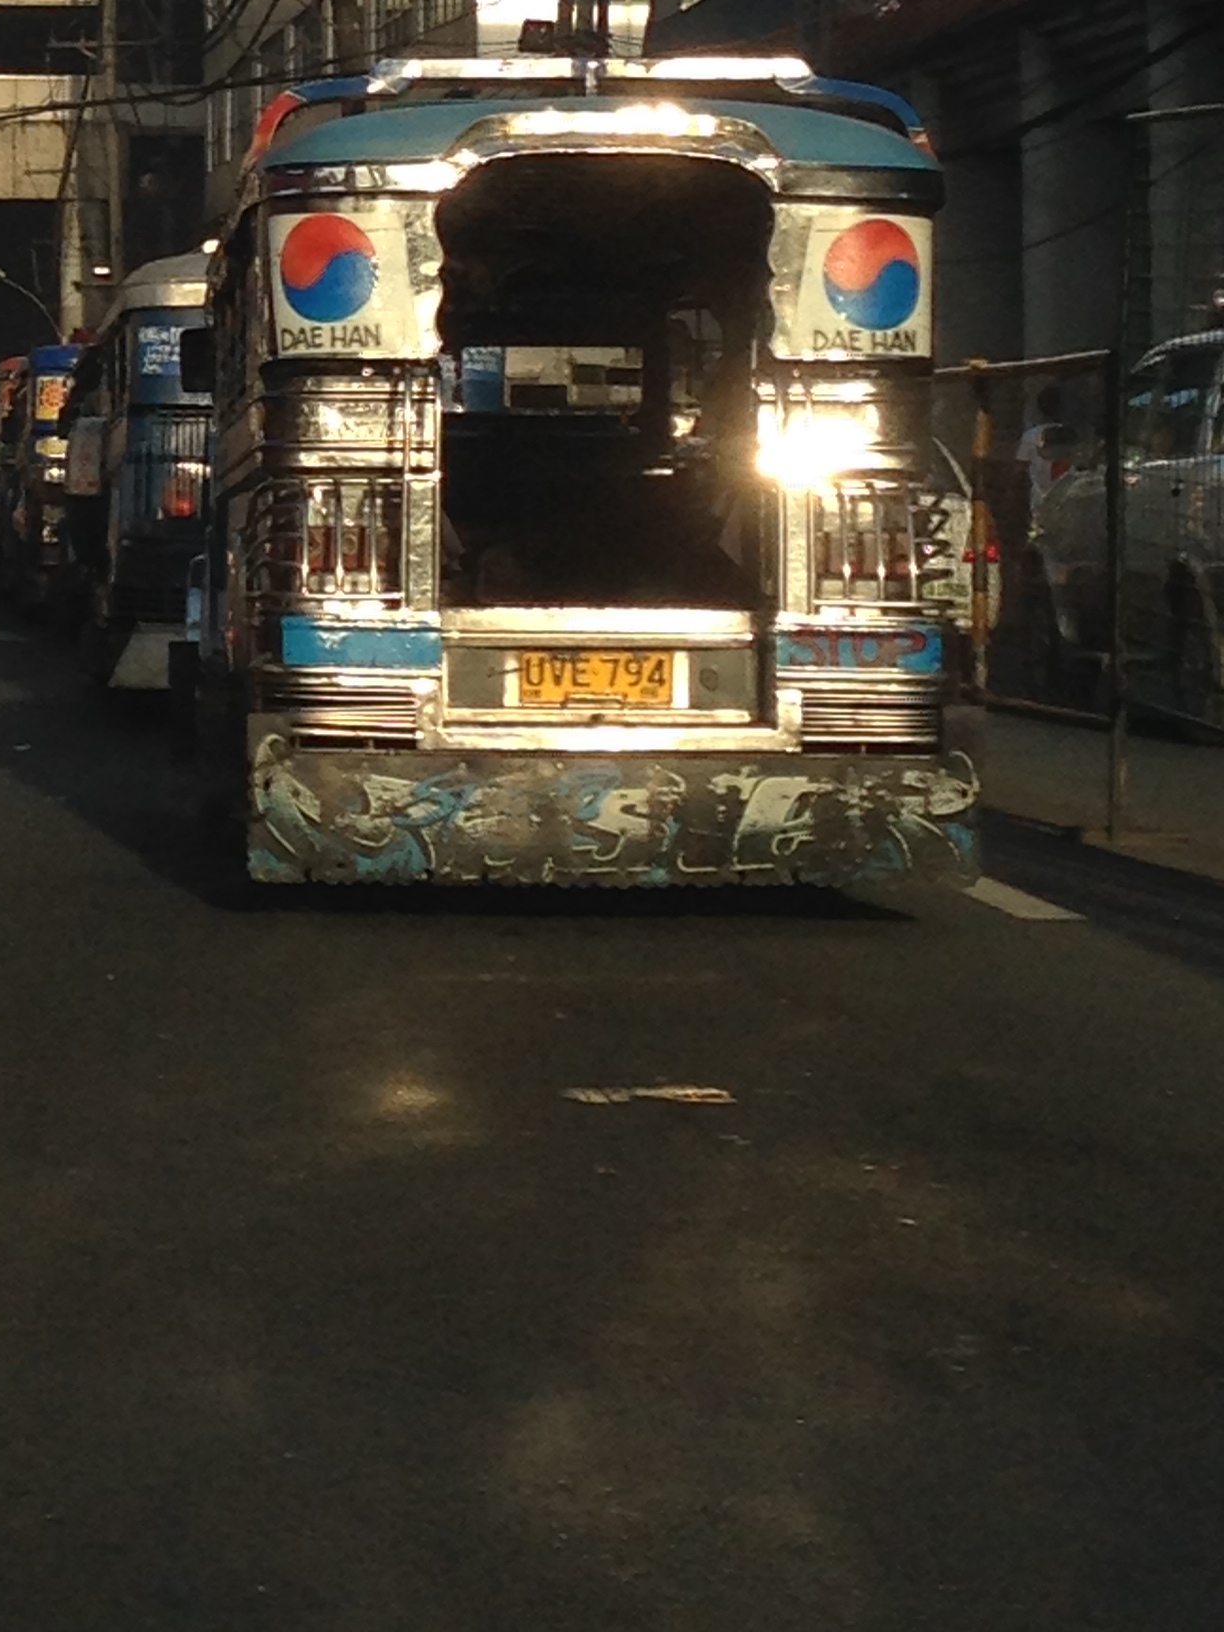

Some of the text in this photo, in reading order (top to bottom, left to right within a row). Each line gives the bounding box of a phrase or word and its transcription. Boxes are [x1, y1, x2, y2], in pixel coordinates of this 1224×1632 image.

[280, 323, 382, 351] DAE HAN
[813, 329, 917, 352] DAE HAN
